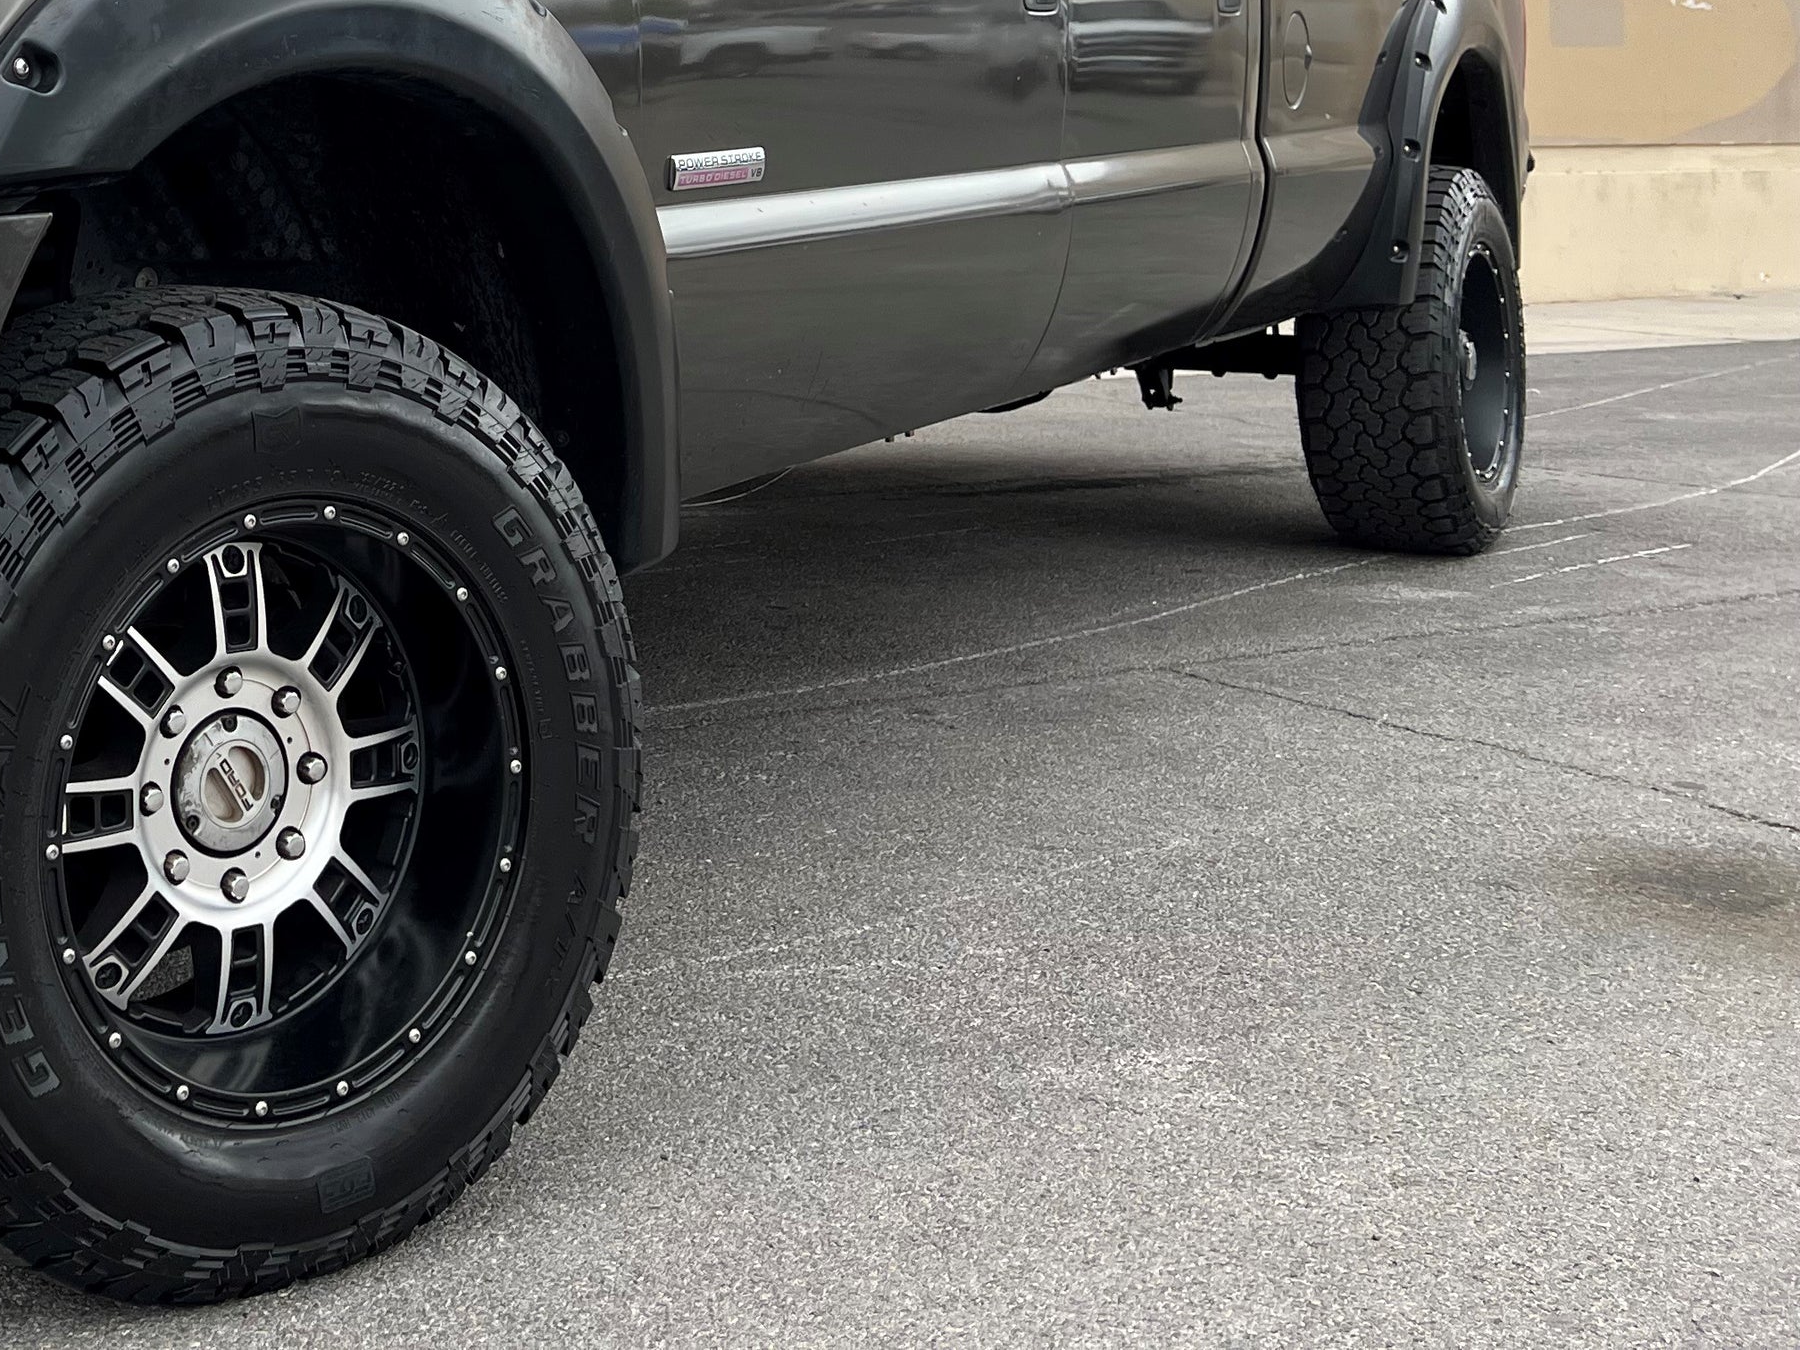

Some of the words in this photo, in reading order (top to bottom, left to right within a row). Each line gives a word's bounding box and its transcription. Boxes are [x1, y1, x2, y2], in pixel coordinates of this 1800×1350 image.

[678, 155, 719, 170] POWER
[720, 151, 762, 165] STROKE
[679, 173, 713, 184] TURBO
[713, 170, 748, 181] DIESEL
[750, 167, 762, 178] V8
[490, 504, 602, 845] GRABBER
[219, 758, 254, 812] FORD
